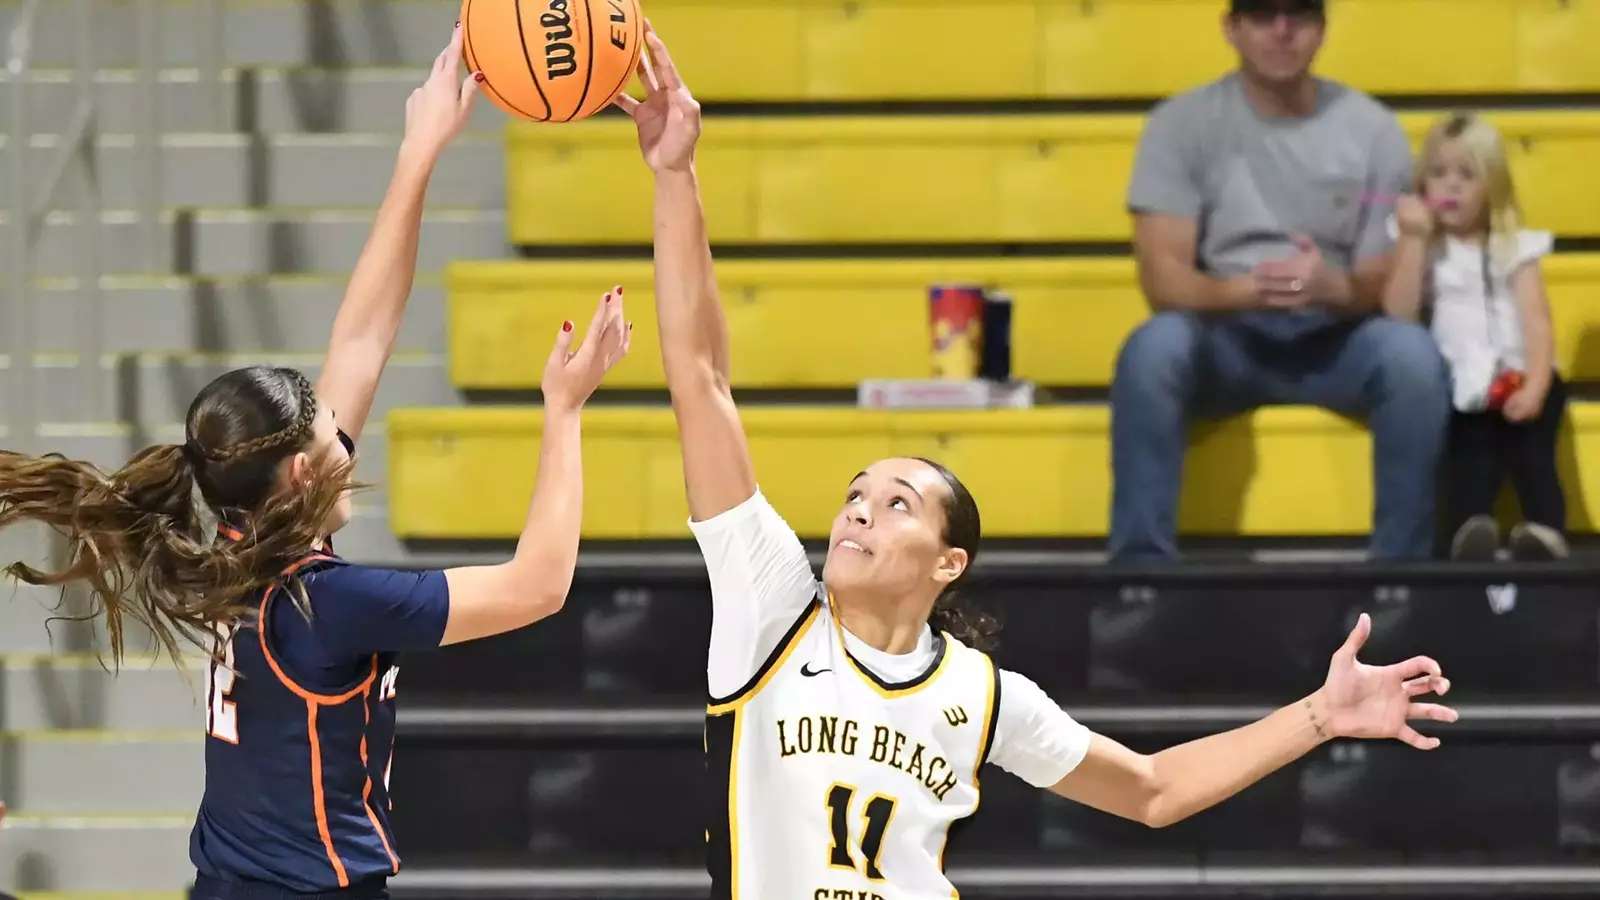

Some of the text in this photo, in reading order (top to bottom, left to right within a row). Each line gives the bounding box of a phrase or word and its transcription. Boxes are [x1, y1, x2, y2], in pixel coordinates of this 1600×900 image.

[607, 0, 627, 50] EV
[777, 716, 957, 801] LONG BEACH
[825, 781, 898, 883] 11
